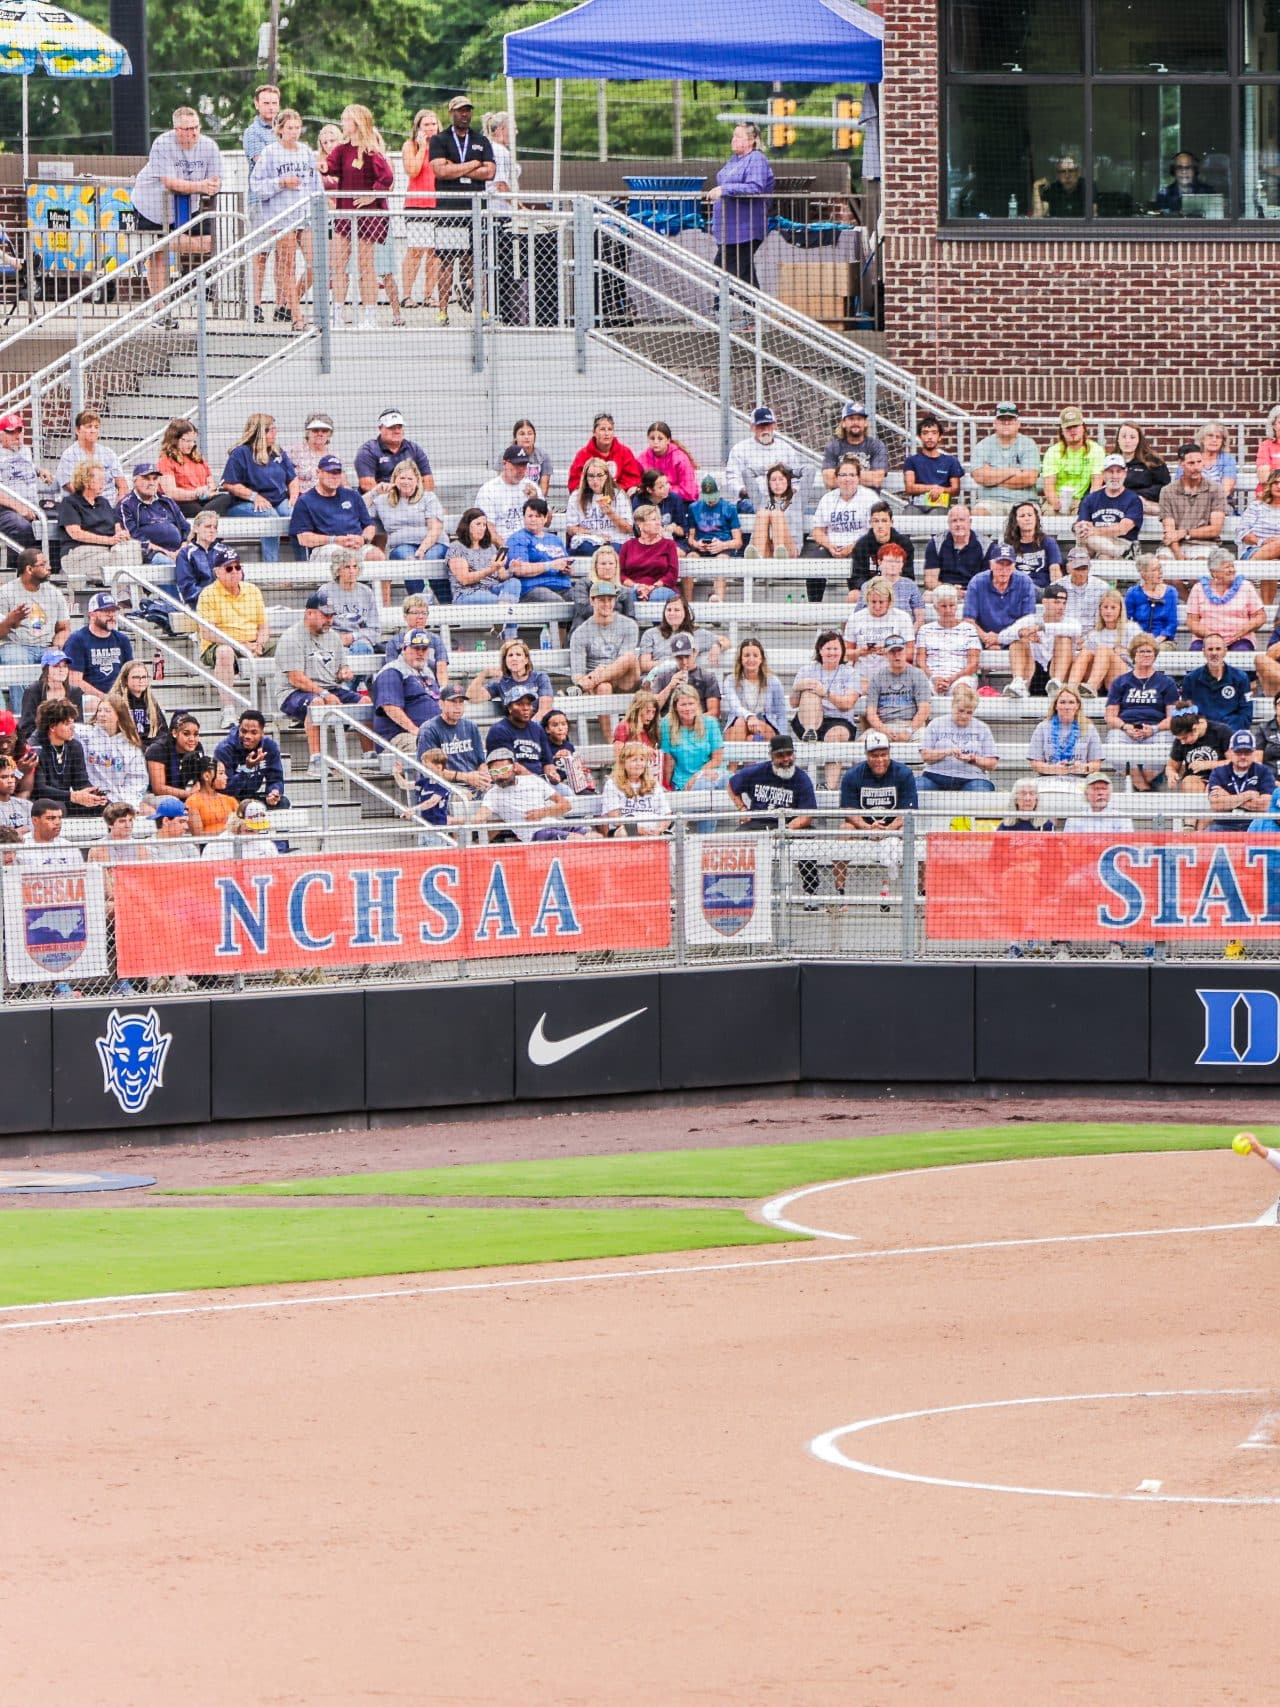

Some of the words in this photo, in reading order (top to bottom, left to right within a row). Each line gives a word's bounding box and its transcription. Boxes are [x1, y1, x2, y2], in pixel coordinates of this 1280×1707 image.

[830, 510, 857, 522] EAST
[1127, 687, 1157, 698] EAST
[702, 848, 756, 872] NCHSAA
[22, 878, 85, 904] NCHSAA
[215, 858, 582, 956] NCHSAA
